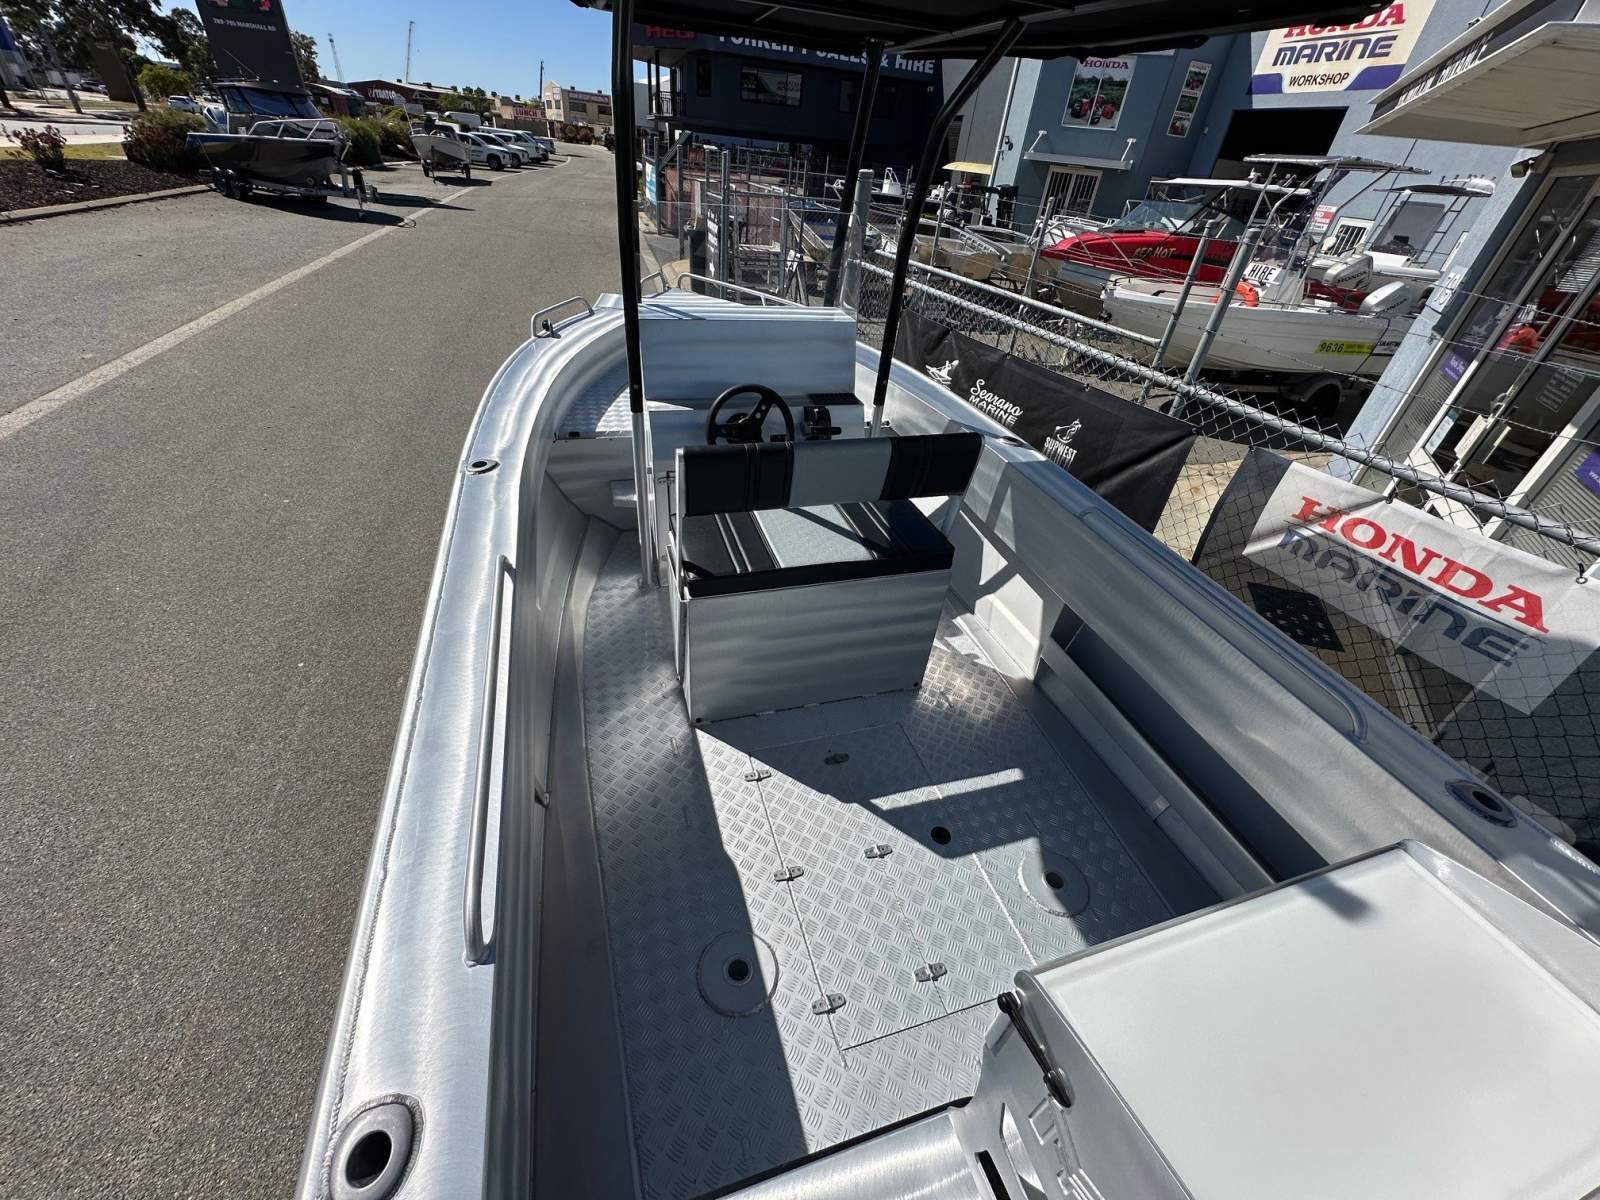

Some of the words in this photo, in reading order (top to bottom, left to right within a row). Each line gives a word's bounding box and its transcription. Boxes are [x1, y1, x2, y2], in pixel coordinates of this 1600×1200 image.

[237, 21, 268, 31] MARSHALL
[1272, 35, 1398, 66] MARINE
[895, 54, 935, 74] HIRE
[1084, 60, 1129, 69] HONDA
[1289, 72, 1350, 87] WORKSHOP
[515, 108, 537, 118] LUNCH
[1154, 246, 1177, 258] HOT
[1248, 264, 1277, 281] HIRE
[970, 379, 1023, 416] Searano
[969, 395, 1018, 425] MARINE
[1044, 436, 1078, 461] SUPWEST
[1291, 496, 1550, 634] HONDA
